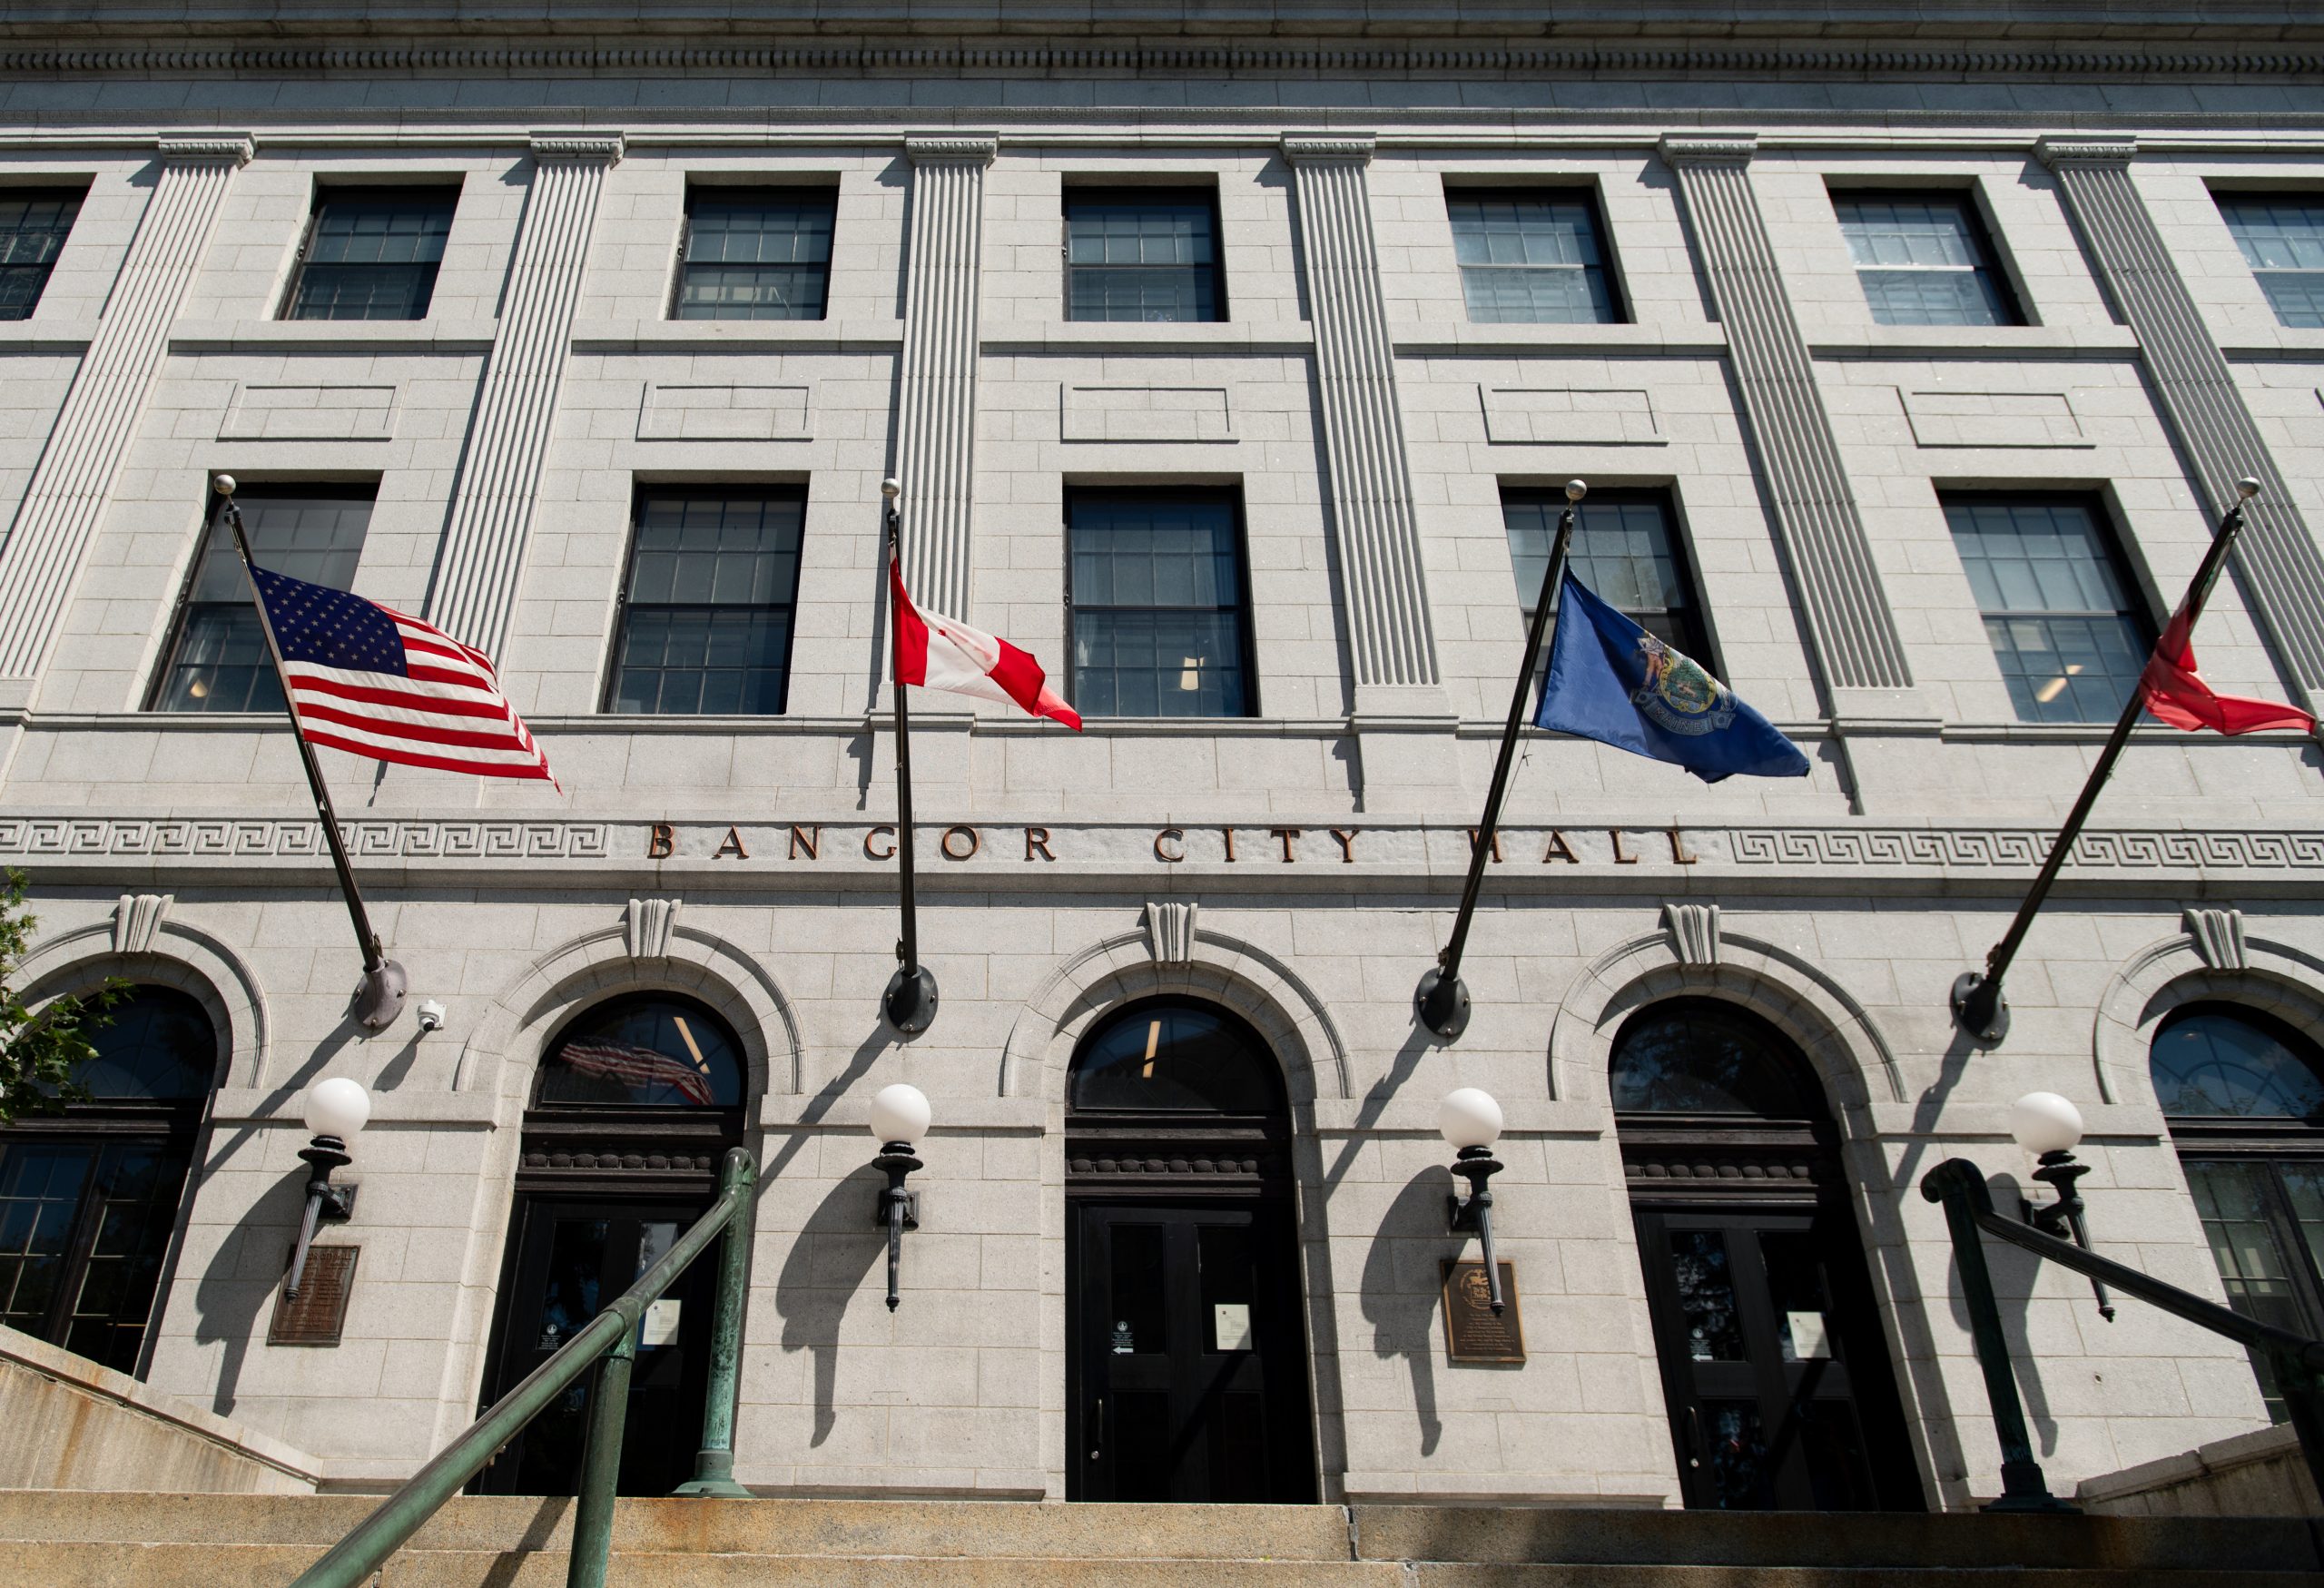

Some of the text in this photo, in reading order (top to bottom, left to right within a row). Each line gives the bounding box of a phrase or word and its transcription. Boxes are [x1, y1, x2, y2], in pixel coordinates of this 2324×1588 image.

[1655, 707, 1701, 732] MAINE
[647, 824, 1697, 864] BANGOR CITY HALL
